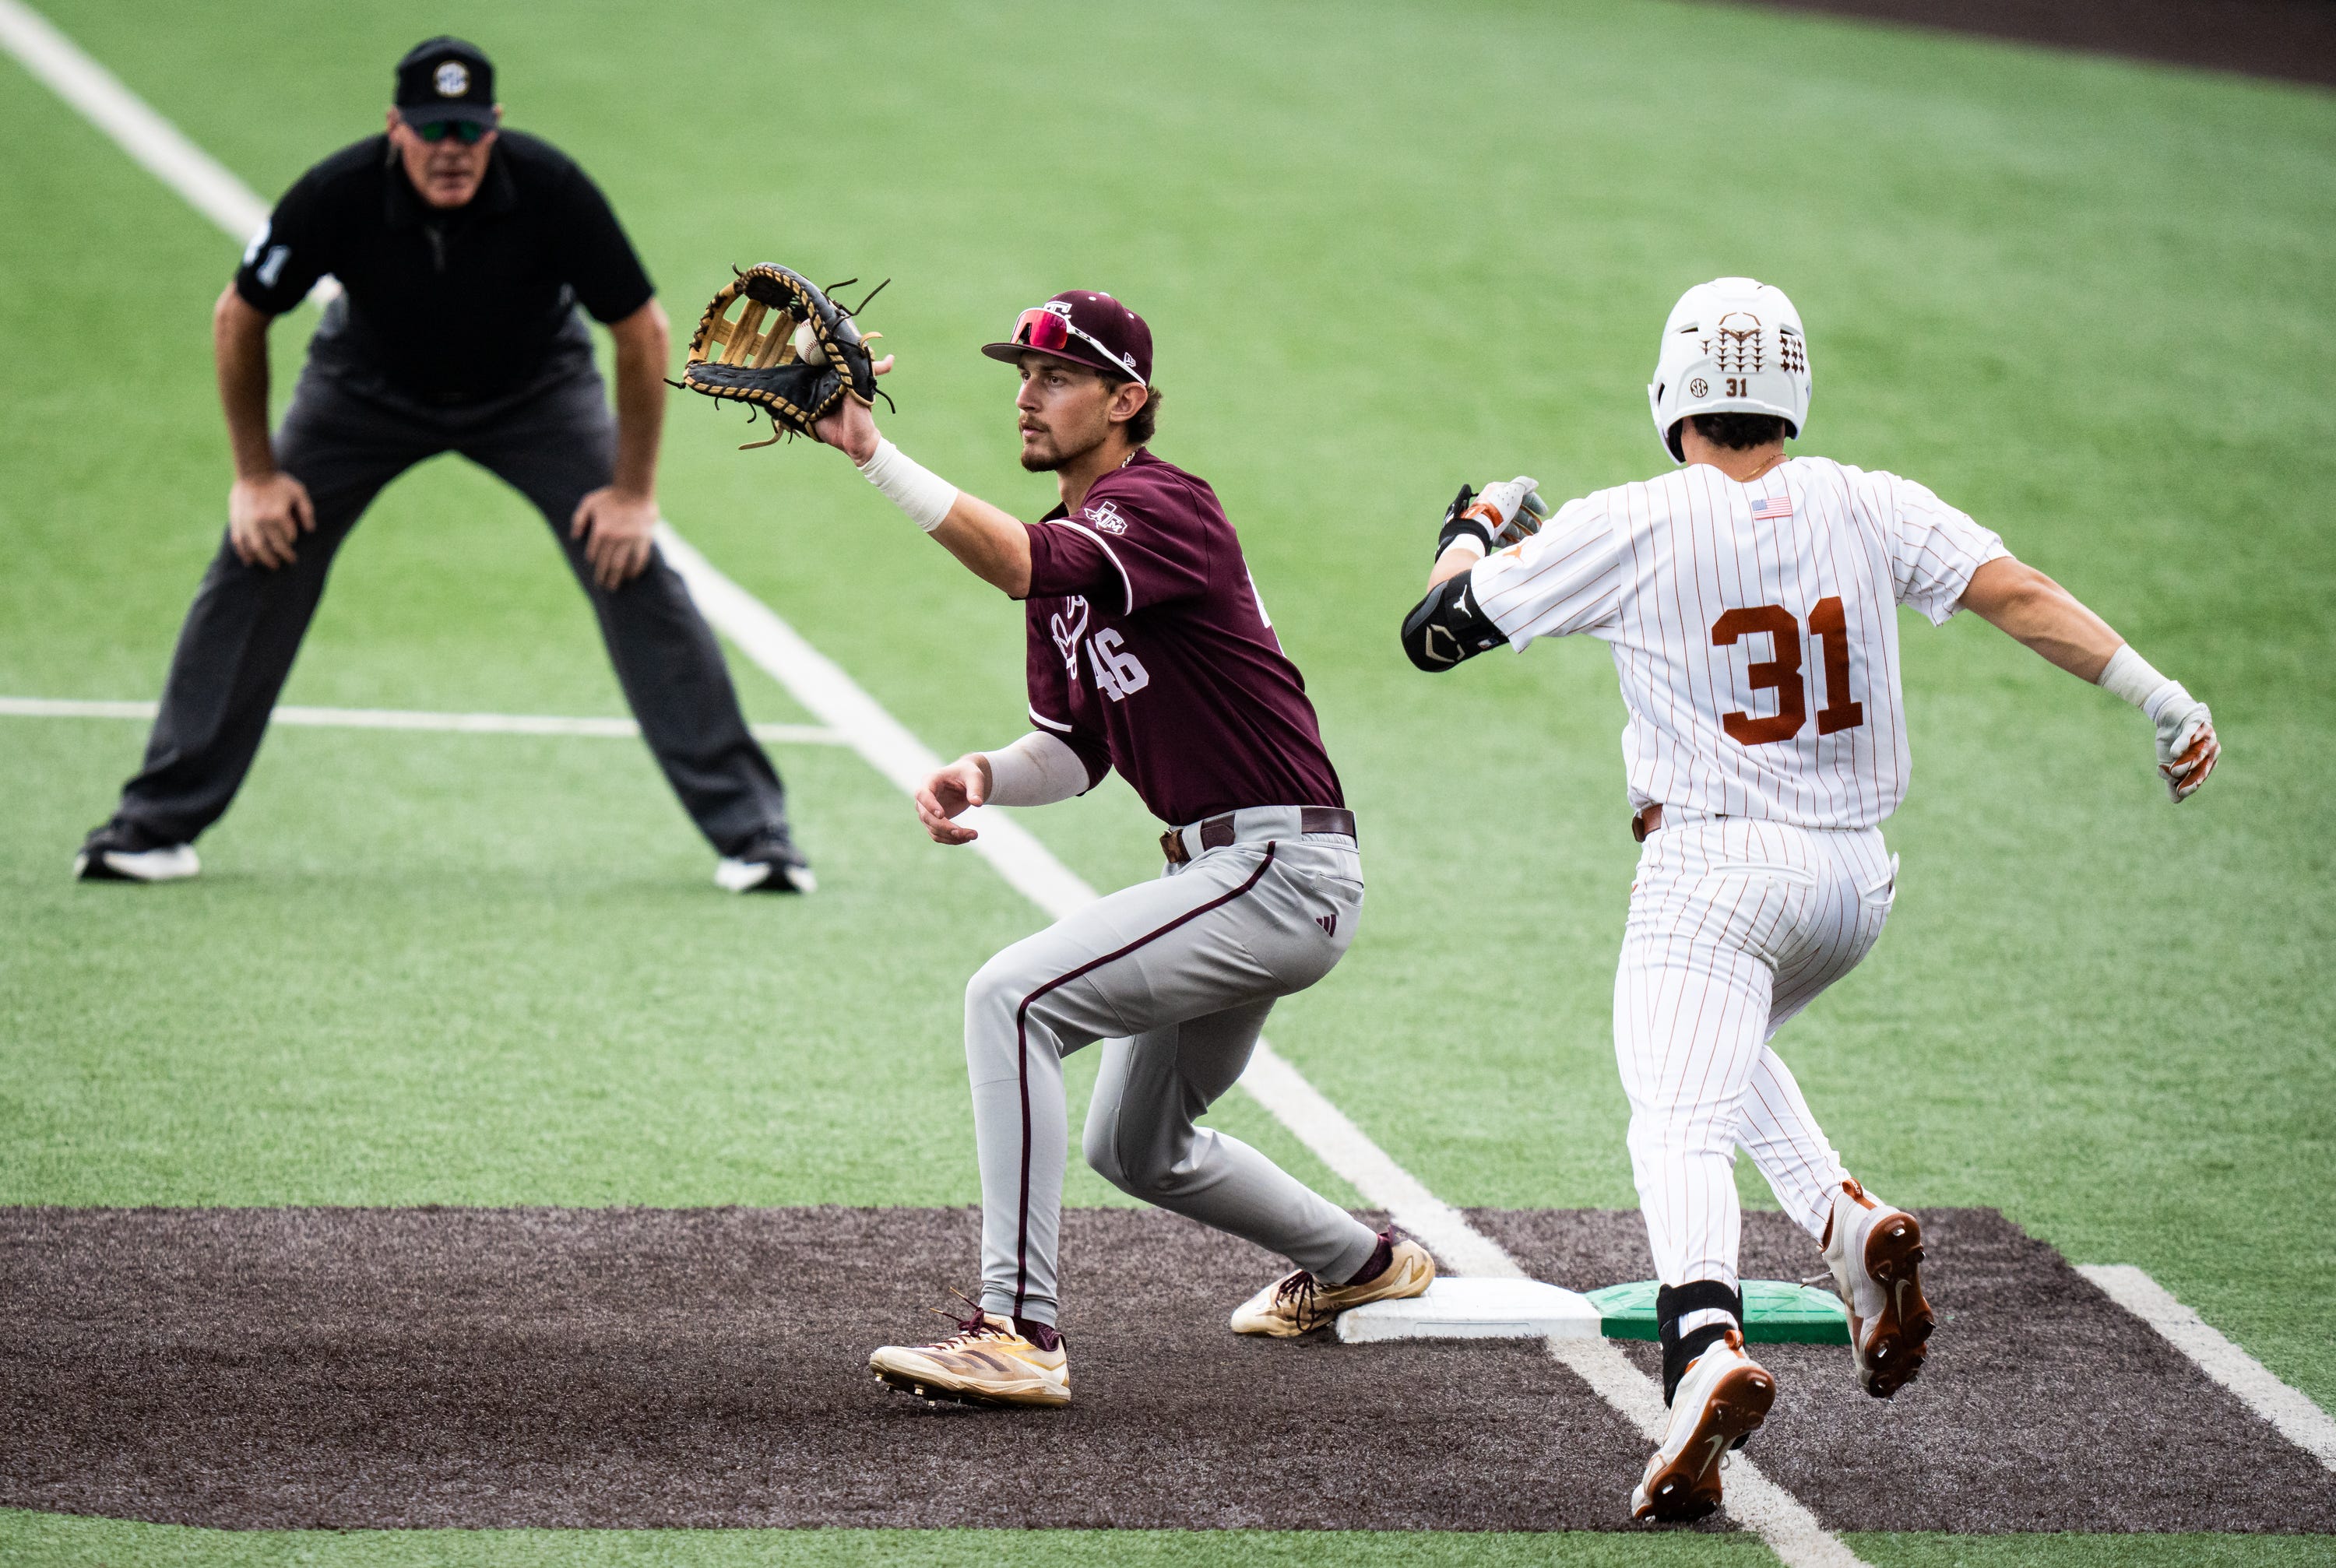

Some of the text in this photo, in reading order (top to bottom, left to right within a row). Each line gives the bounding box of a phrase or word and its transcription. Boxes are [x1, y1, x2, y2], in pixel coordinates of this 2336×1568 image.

[1726, 378, 1747, 397] 31
[1085, 628, 1150, 702] 46
[1712, 596, 1863, 746] 31
